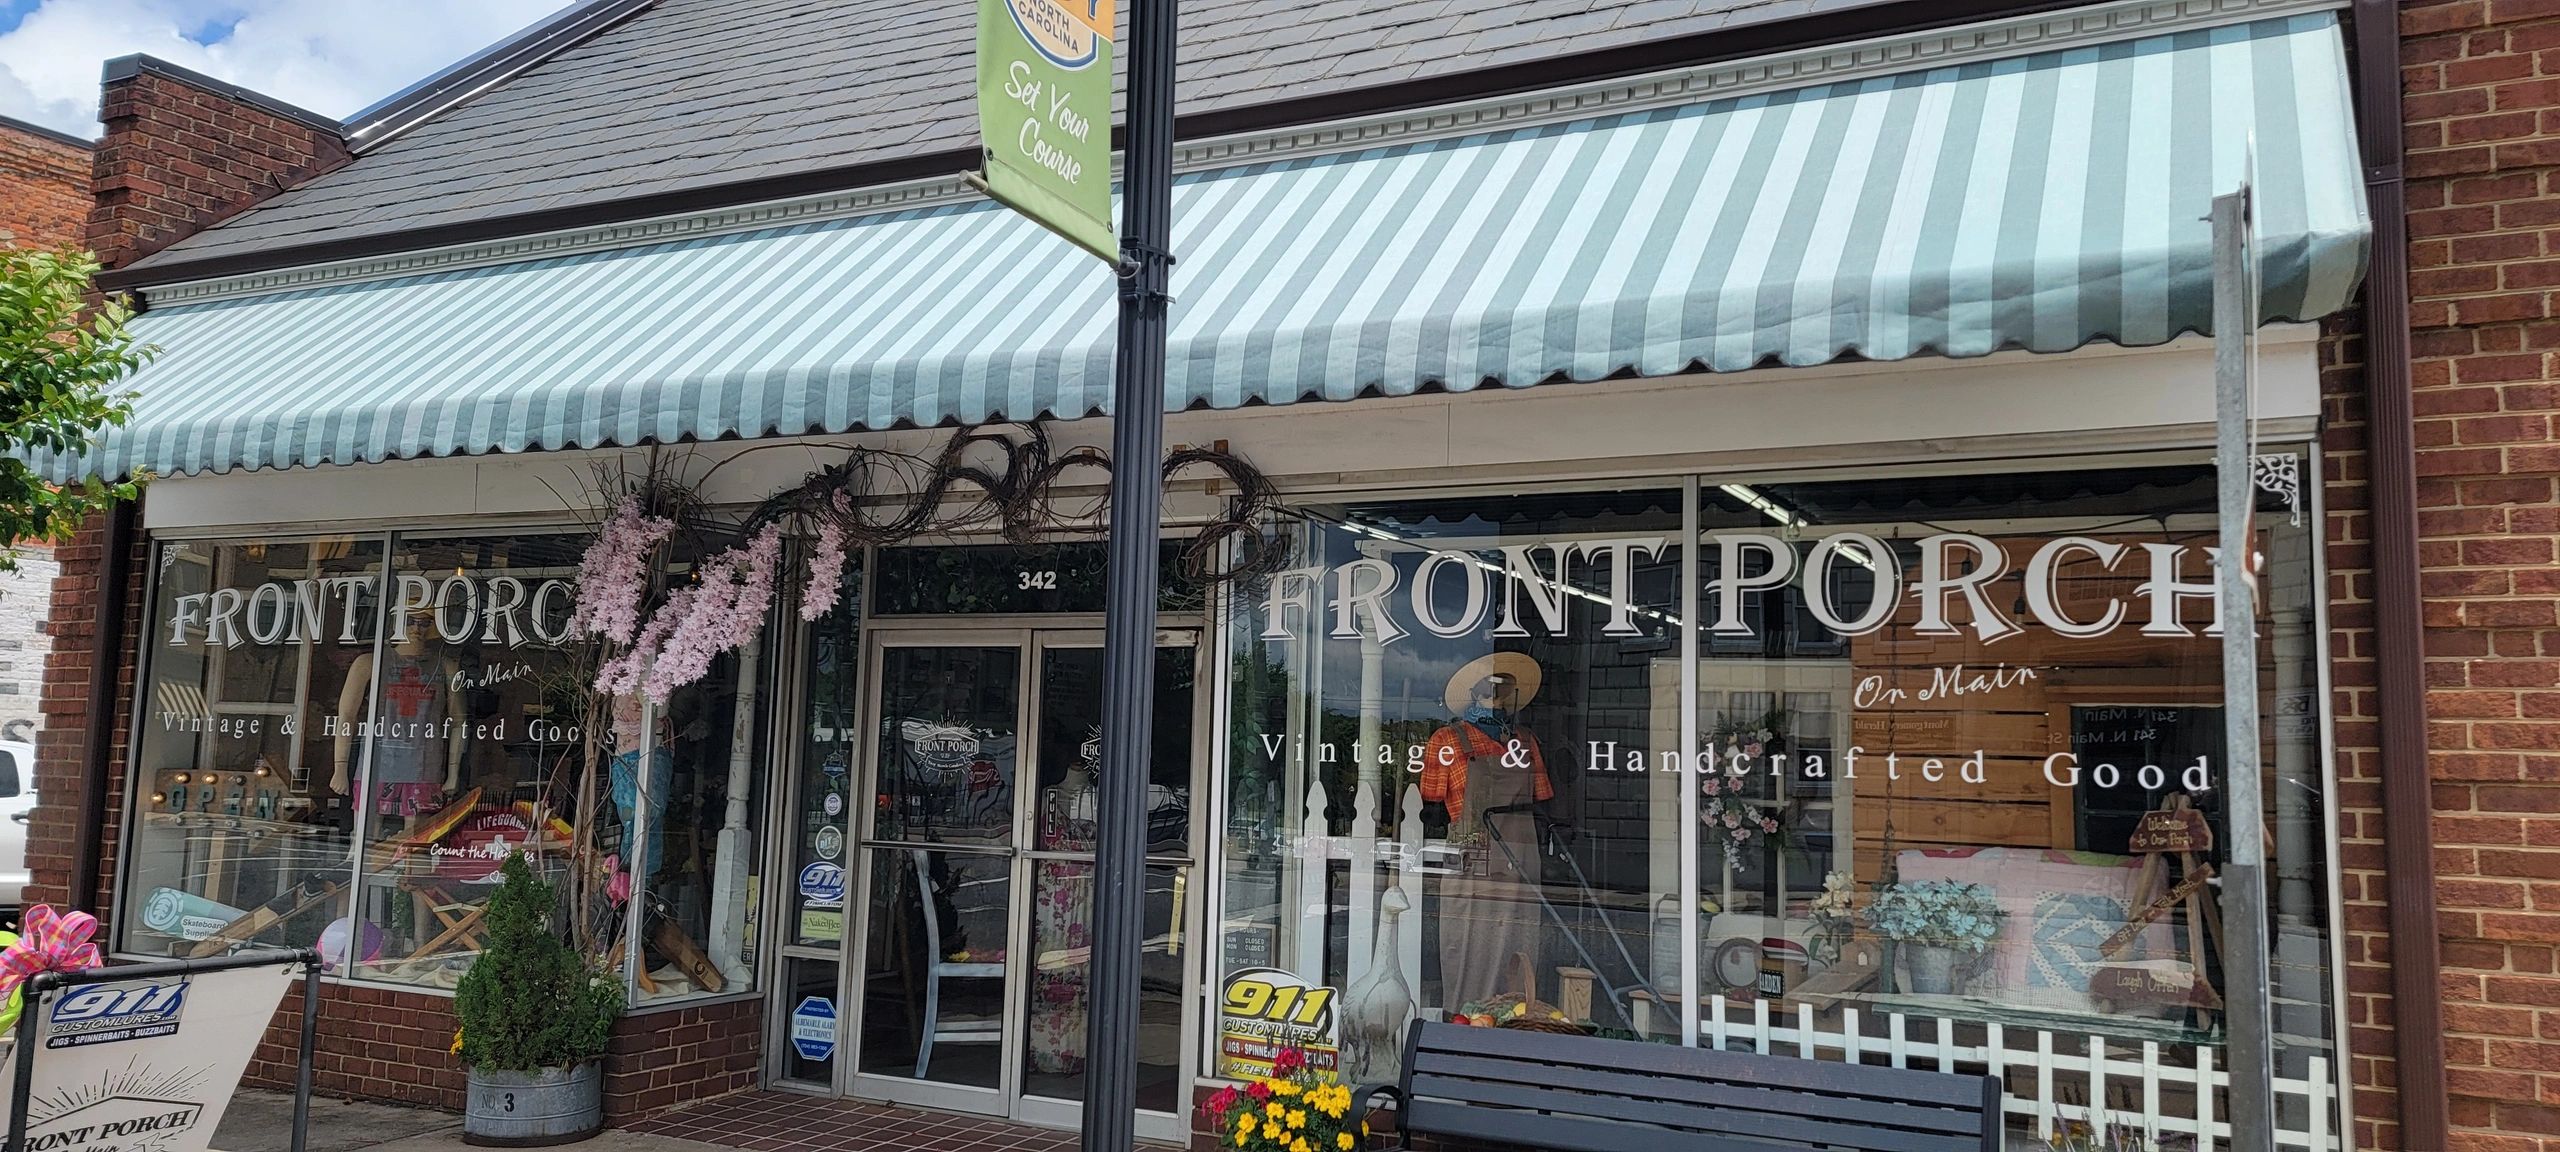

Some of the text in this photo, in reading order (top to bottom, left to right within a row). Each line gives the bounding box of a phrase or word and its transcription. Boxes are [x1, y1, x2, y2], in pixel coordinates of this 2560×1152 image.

[1018, 2, 1079, 54] CAROLINA
[1004, 60, 1091, 144] Set Your
[1019, 117, 1081, 184] Course
[1018, 571, 1057, 590] 342
[1259, 531, 2261, 646] FRONT PORCH
[169, 575, 590, 651] FRONT PORC
[451, 669, 474, 692] On
[479, 661, 532, 687] Main
[1853, 662, 2038, 708] On Main
[162, 713, 615, 744] Vintage & Handcrafted Goos
[917, 740, 977, 752] FRONT PORCH
[1084, 744, 1101, 755] FRO
[1260, 732, 2212, 792] Vintage & Handcrafted Good
[167, 784, 281, 821] OPEN
[1048, 791, 1056, 834] PULL
[430, 843, 466, 857] Count
[468, 846, 488, 858] the
[803, 868, 845, 888] 911
[182, 919, 225, 929] Skateboard
[53, 982, 190, 1021] 911
[1223, 980, 1335, 1027] 911
[50, 1025, 175, 1047] JIGS SPINNERBAITS BUZZBAITS
[1226, 1041, 1240, 1053] JIGS
[504, 1092, 515, 1112] 3
[96, 1109, 195, 1140] PORCH
